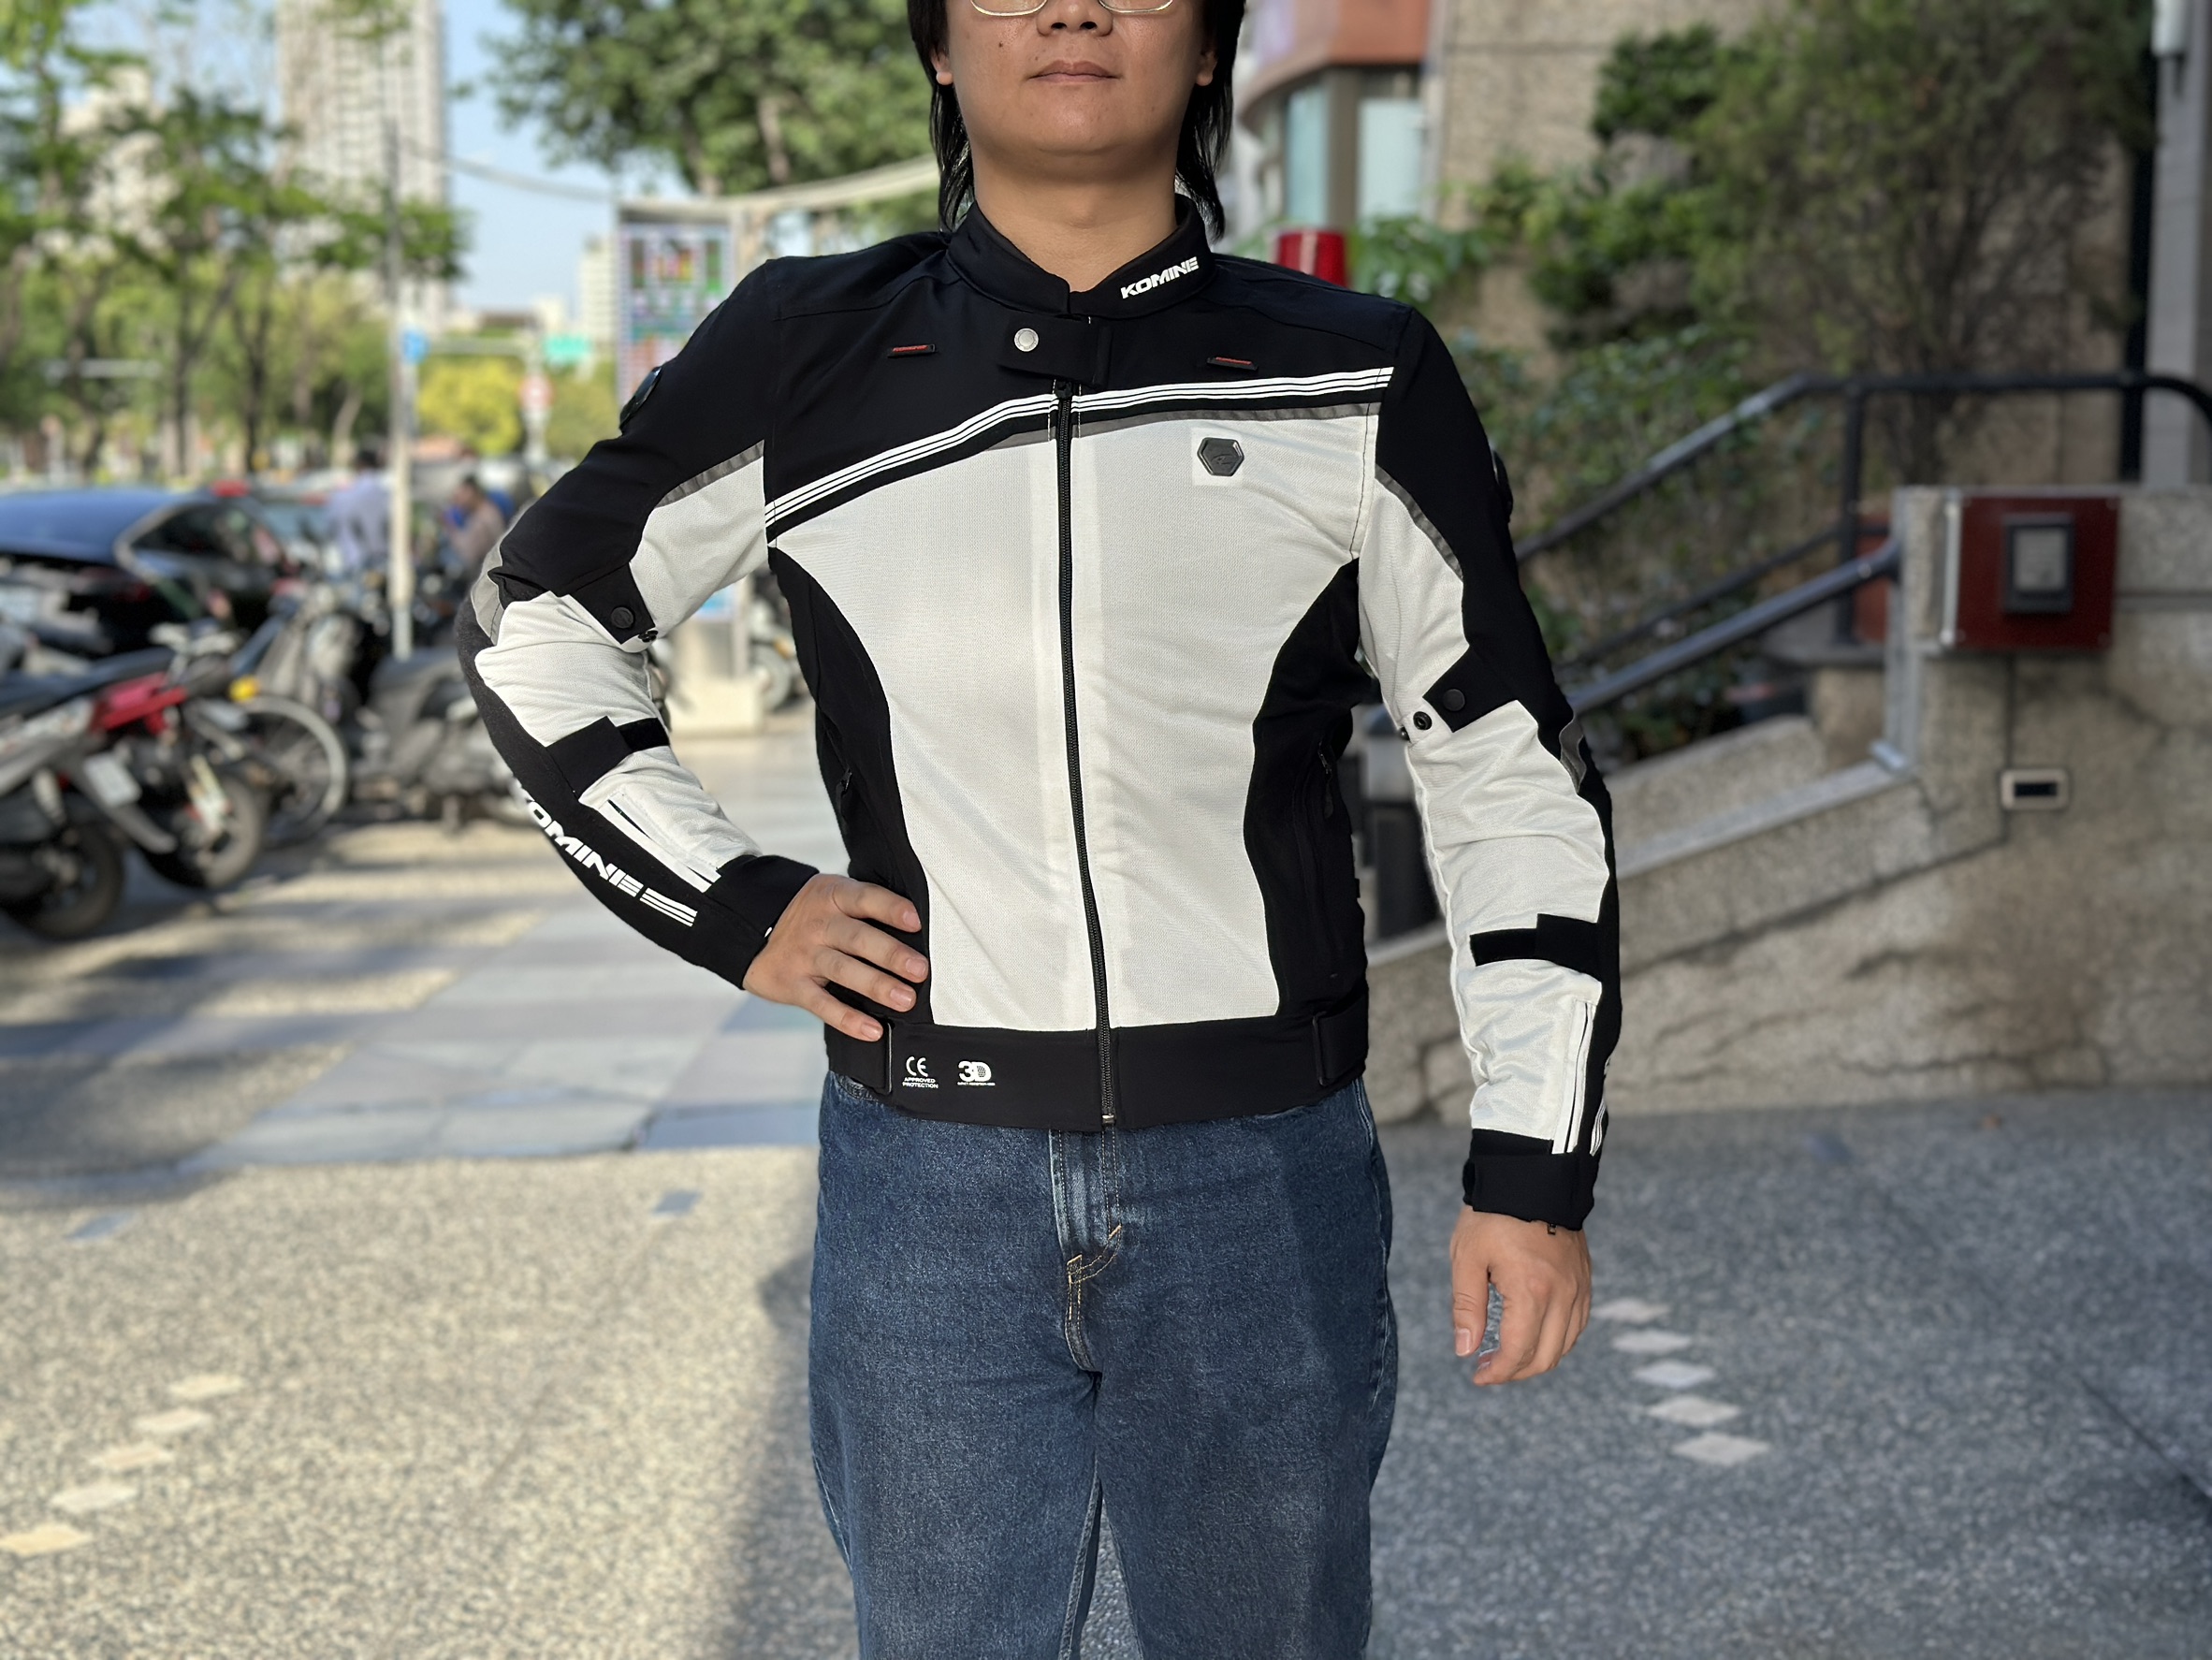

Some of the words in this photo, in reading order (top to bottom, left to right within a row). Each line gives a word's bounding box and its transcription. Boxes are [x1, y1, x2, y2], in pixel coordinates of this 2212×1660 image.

[1120, 255, 1200, 299] KOMINE
[906, 1056, 928, 1077] CE
[957, 1060, 992, 1083] 3D
